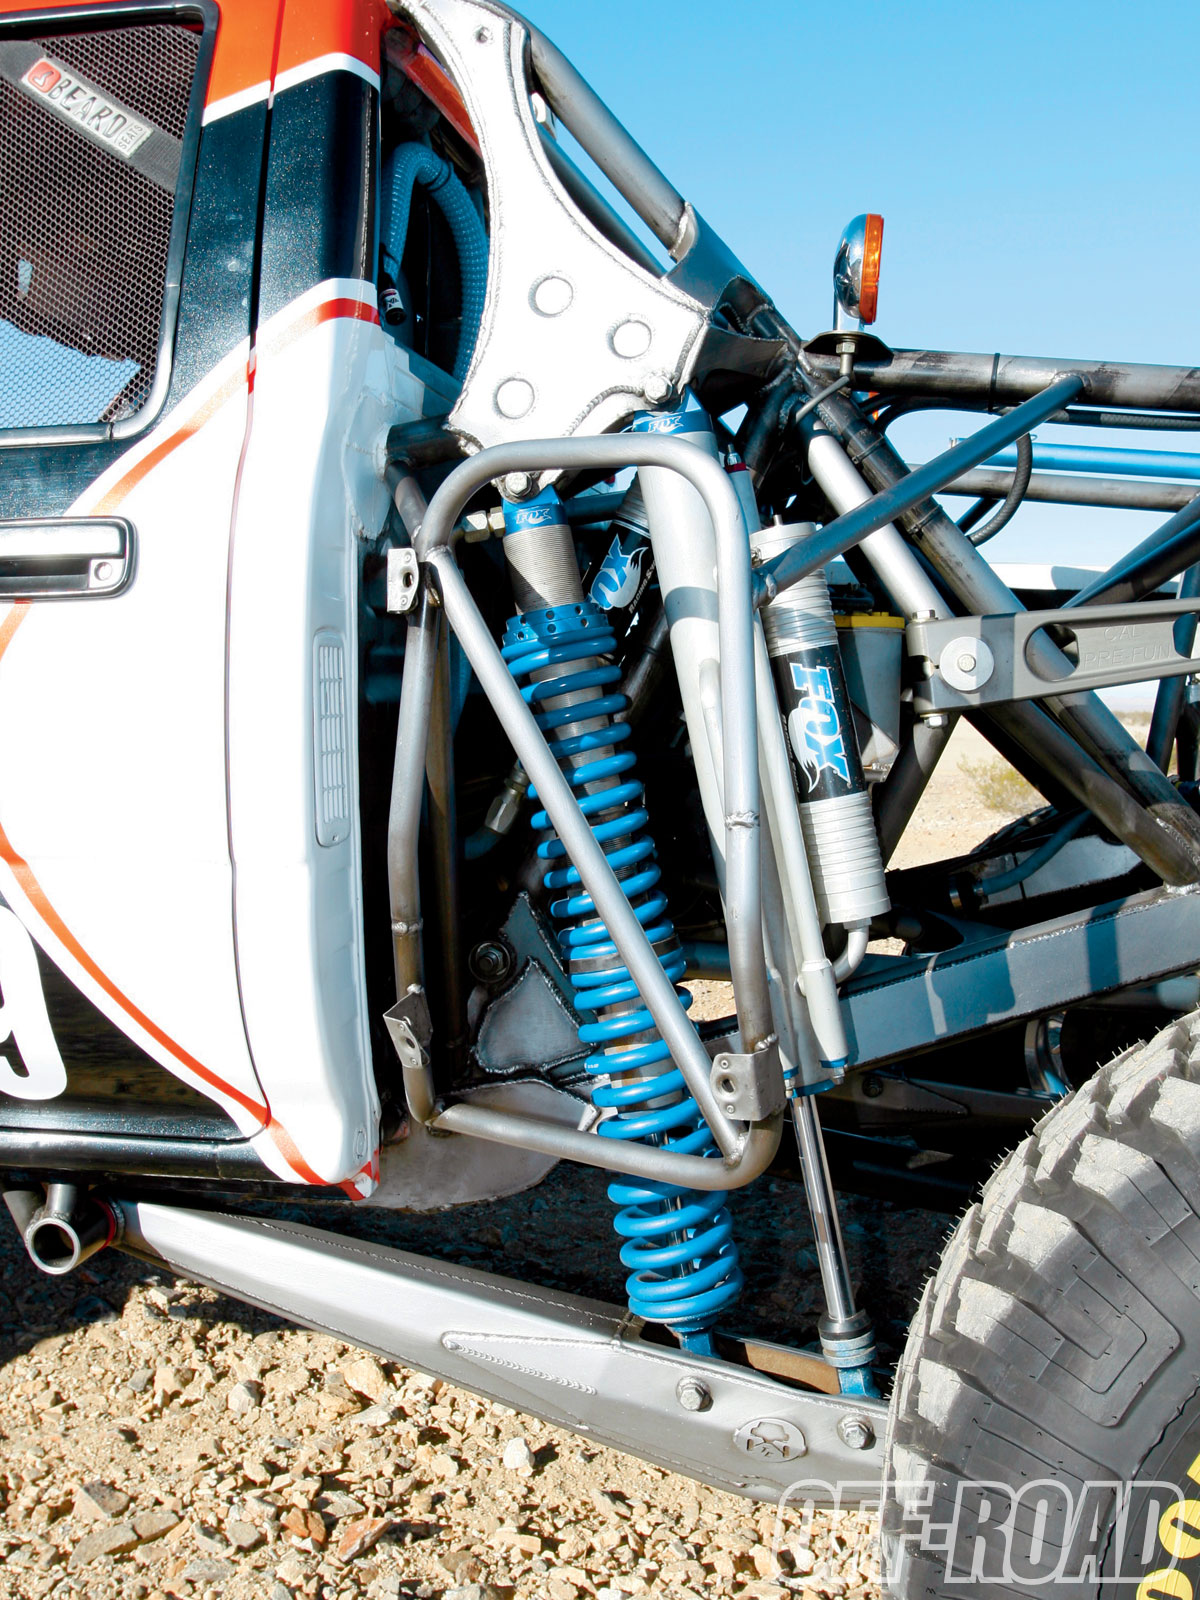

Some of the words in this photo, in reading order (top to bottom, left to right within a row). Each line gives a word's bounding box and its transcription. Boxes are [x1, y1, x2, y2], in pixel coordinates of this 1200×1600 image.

[48, 78, 128, 139] BEARD
[118, 124, 143, 150] SEATS
[648, 415, 684, 433] FOX
[516, 508, 552, 525] FOX
[588, 533, 649, 610] OX
[1104, 624, 1142, 642] CAL
[788, 662, 851, 793] FOX
